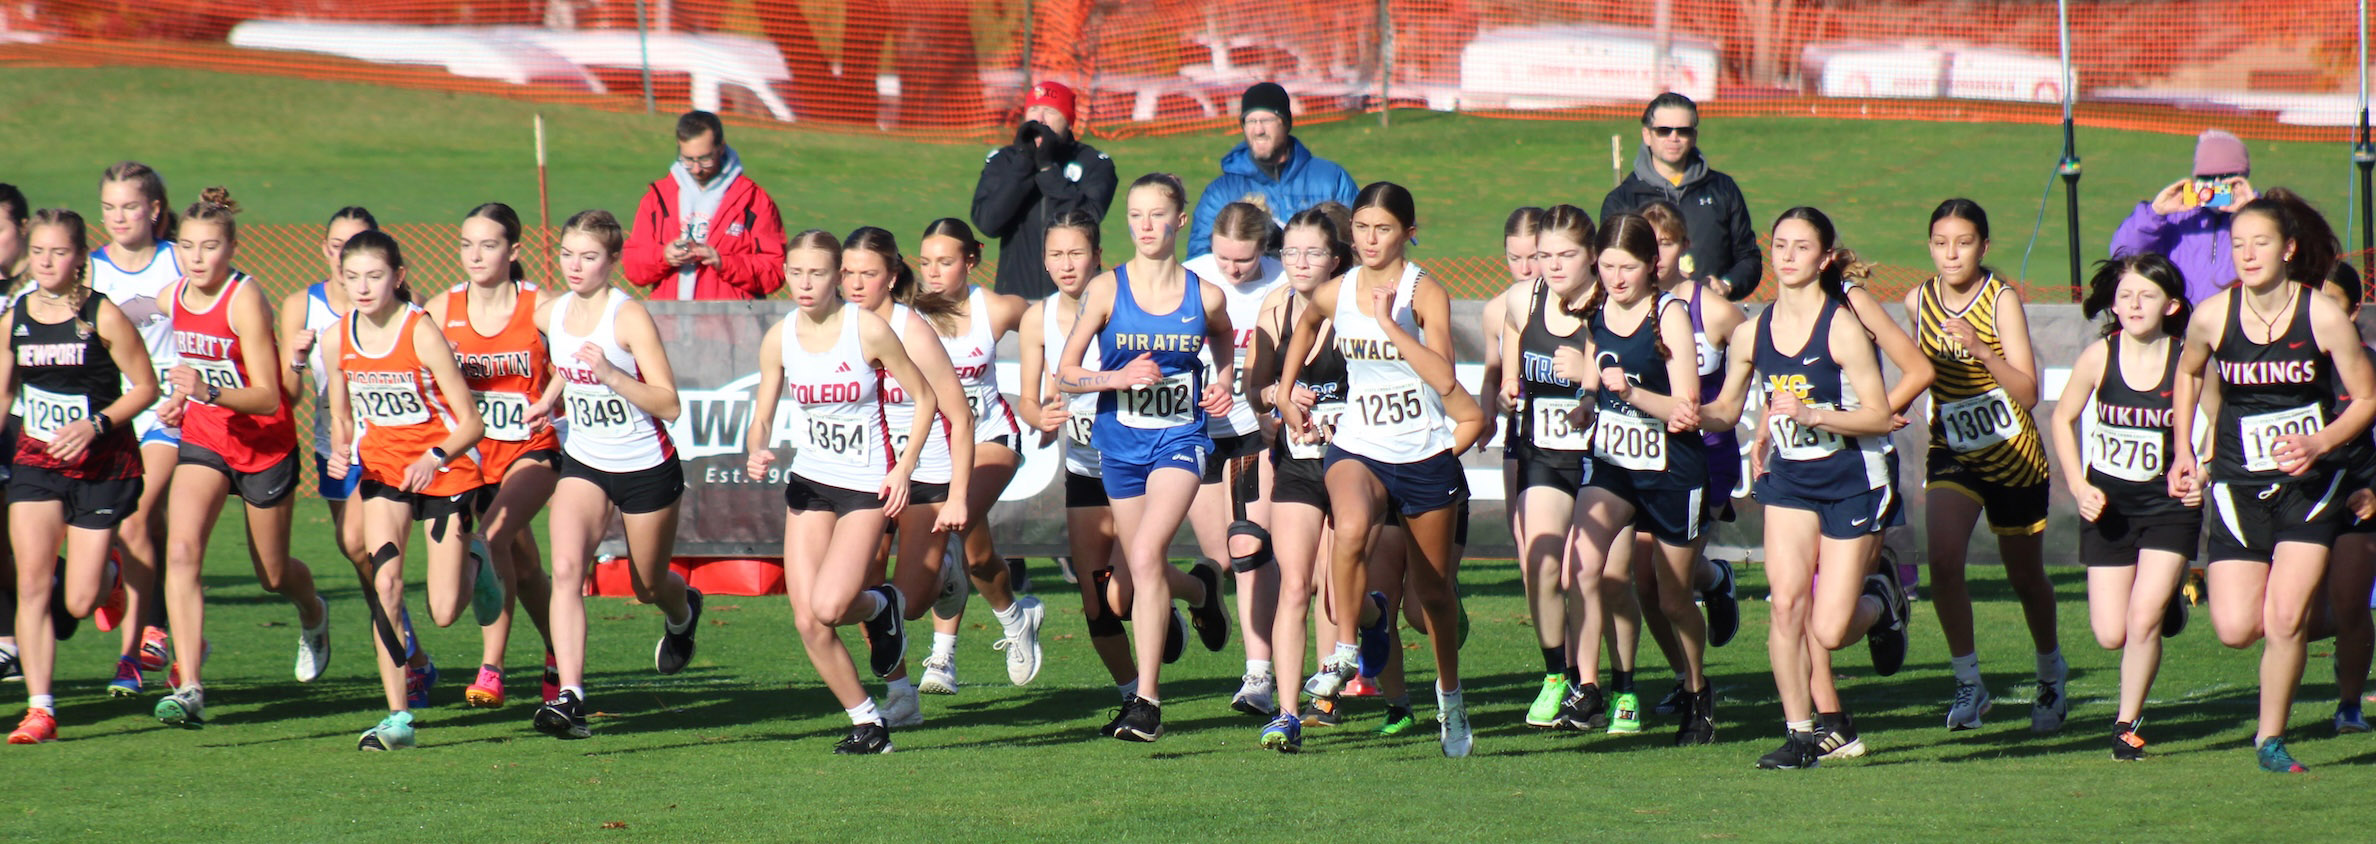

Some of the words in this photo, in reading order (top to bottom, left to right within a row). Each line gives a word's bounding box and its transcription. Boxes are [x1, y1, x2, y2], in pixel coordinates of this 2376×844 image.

[16, 343, 87, 367] NEWPORT
[174, 330, 234, 359] BERTY
[1115, 333, 1201, 353] PIRATES
[1338, 337, 1405, 361] LWAC
[1768, 374, 1808, 400] XC
[2219, 360, 2316, 385] VIKINGS
[355, 391, 421, 417] 1203
[790, 381, 861, 405] TOLEDO
[1122, 384, 1189, 418] 1202
[1355, 389, 1422, 426] 1255
[28, 398, 83, 431] 1298
[477, 400, 525, 430] 204
[568, 396, 627, 427] 1349
[1946, 400, 2012, 443] 1300
[2098, 402, 2174, 428] VIKING
[807, 417, 864, 456] 1354
[1602, 423, 1661, 458] 1208
[2097, 434, 2158, 471] 1276
